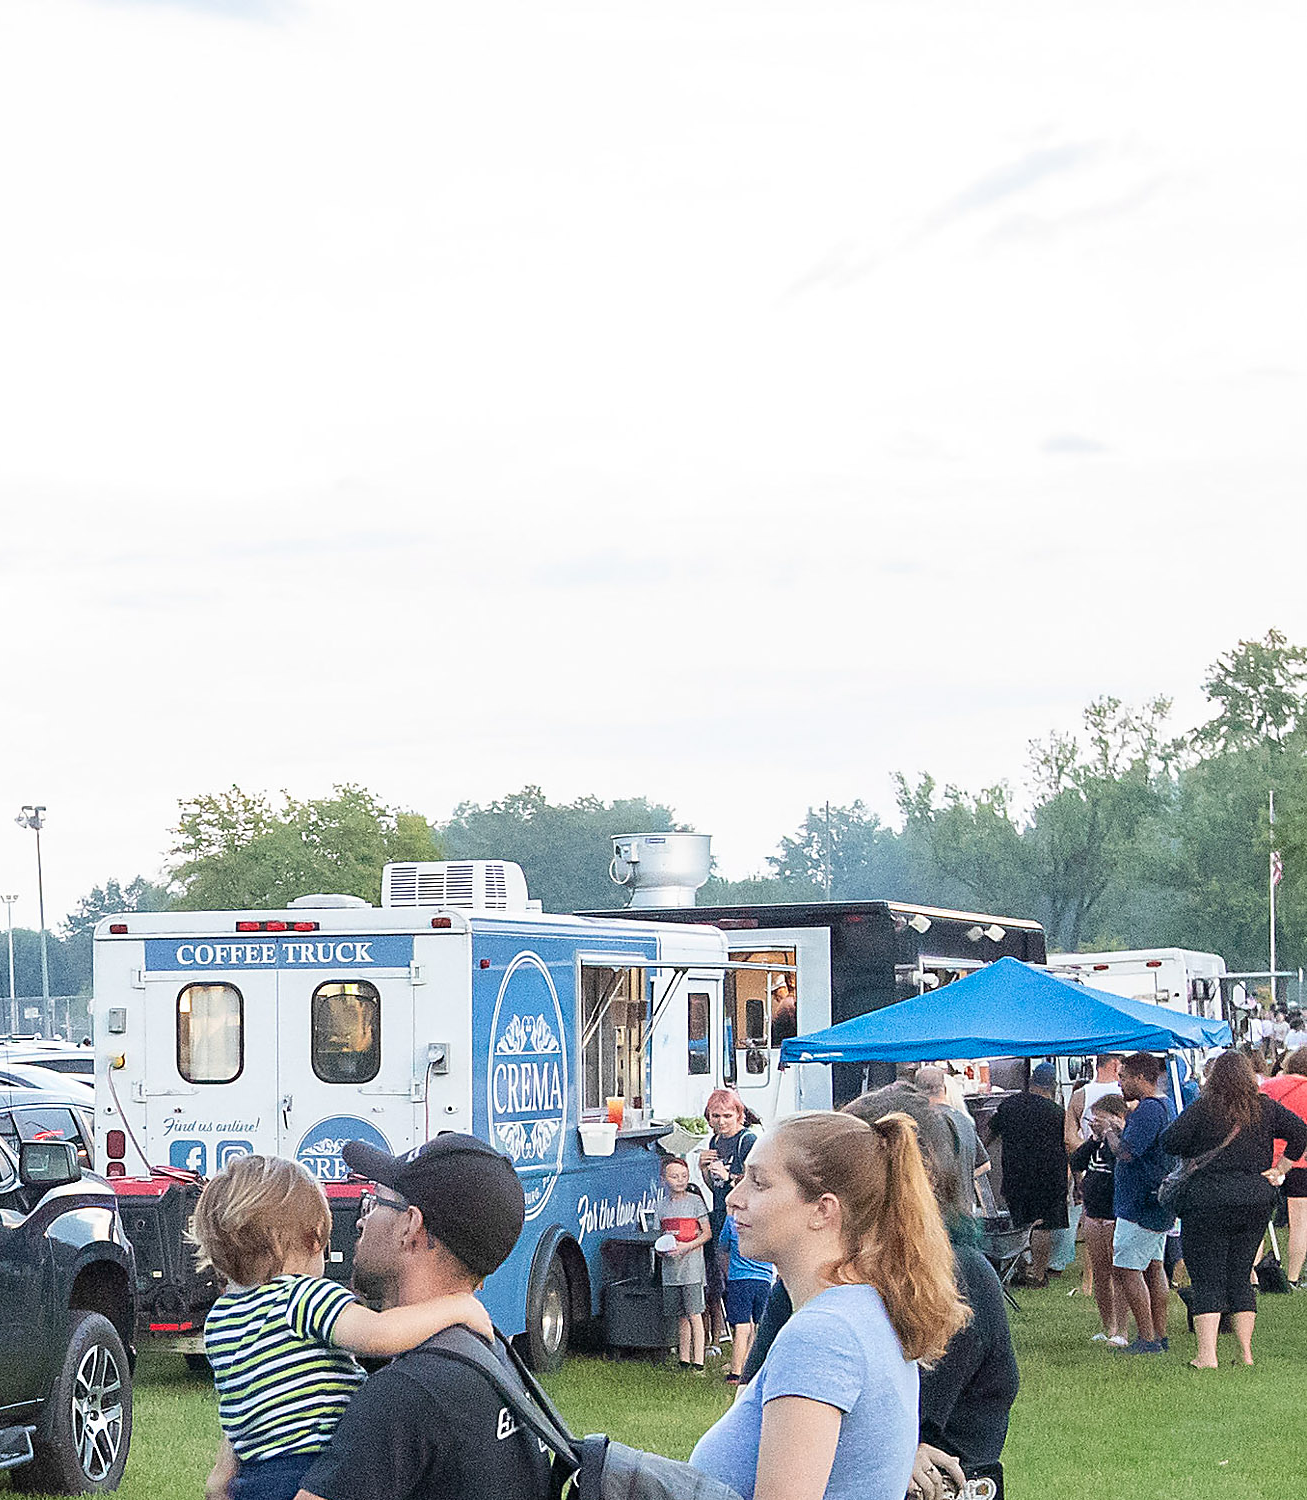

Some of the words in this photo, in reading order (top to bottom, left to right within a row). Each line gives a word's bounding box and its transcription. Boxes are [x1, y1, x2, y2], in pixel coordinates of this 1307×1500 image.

[176, 942, 276, 966] COFFEE
[282, 940, 374, 964] TRUCK
[493, 1062, 562, 1115] CREMA
[163, 1117, 195, 1136] Find
[198, 1122, 213, 1133] us
[216, 1116, 261, 1133] online!
[577, 1194, 598, 1245] For
[598, 1198, 615, 1230] the
[616, 1195, 635, 1227] love
